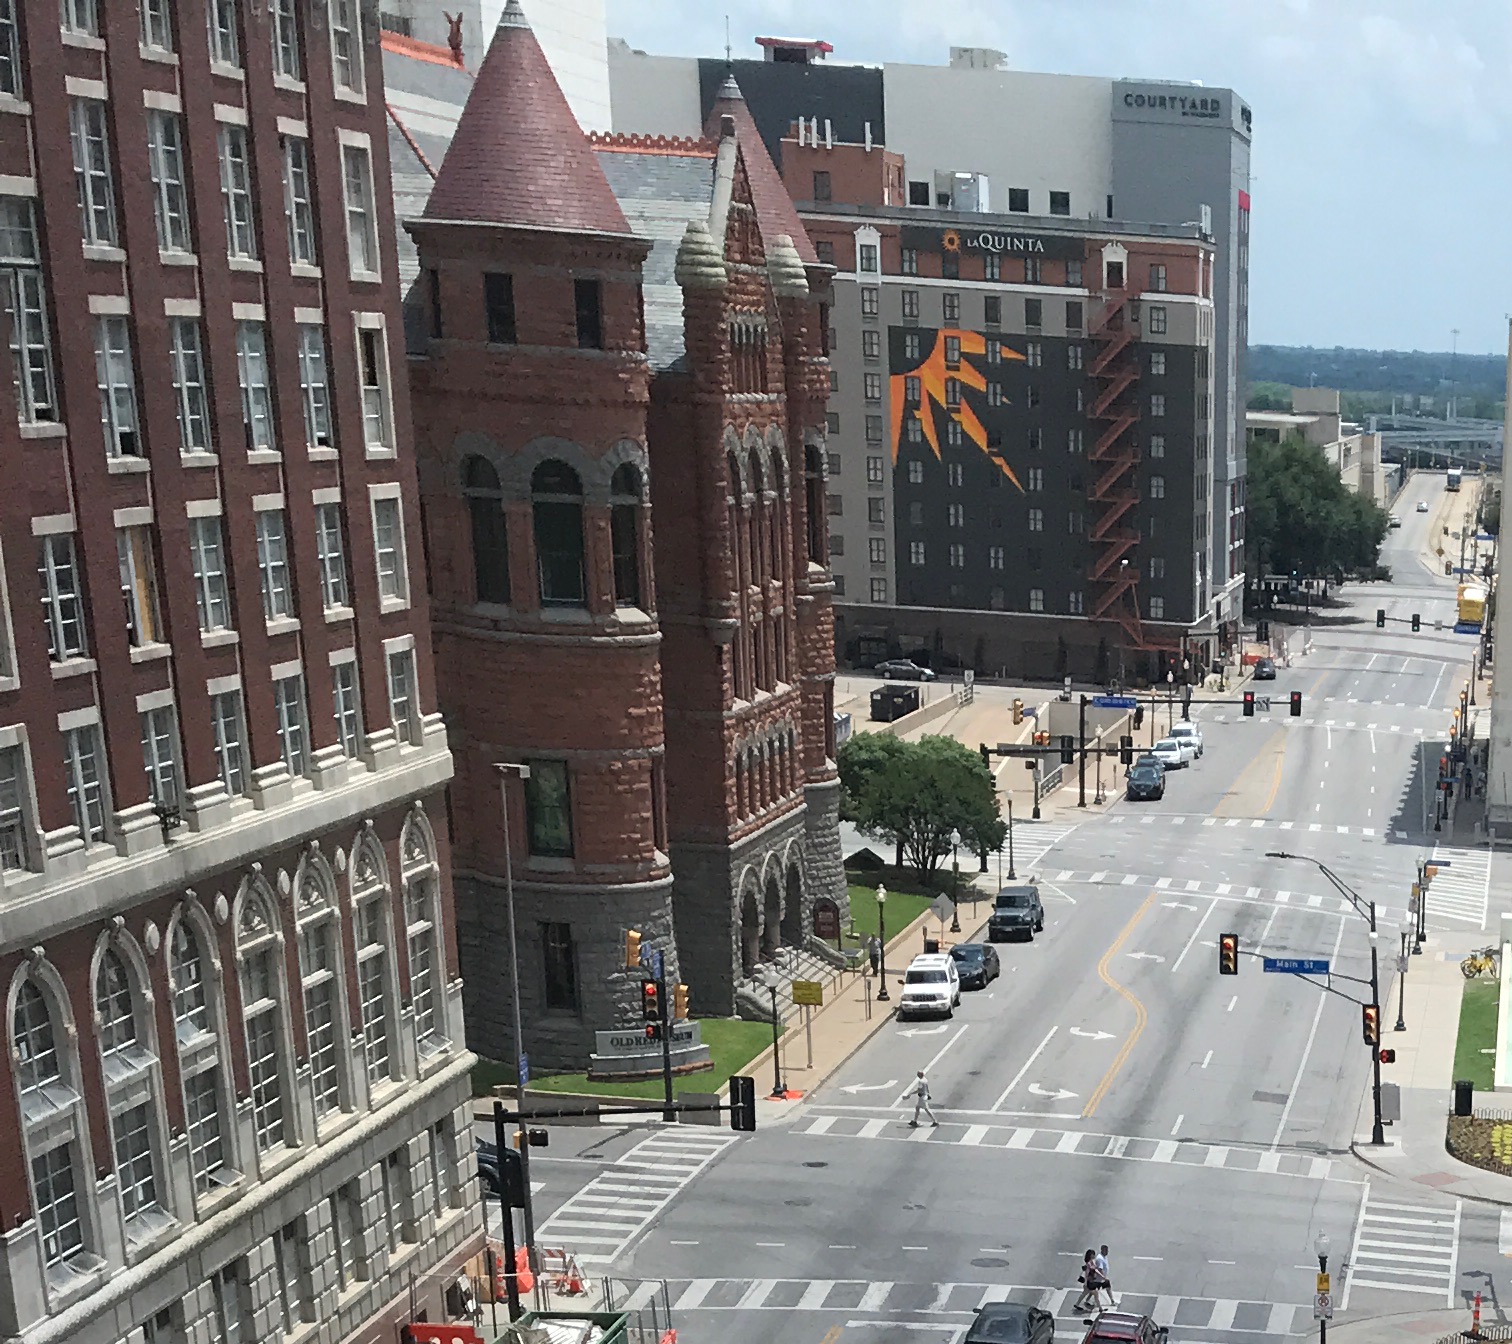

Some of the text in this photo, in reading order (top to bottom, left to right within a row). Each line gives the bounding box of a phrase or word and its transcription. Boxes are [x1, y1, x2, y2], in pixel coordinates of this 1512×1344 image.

[1124, 93, 1220, 112] COURTYARD
[1276, 960, 1314, 969] Main St
[610, 1037, 633, 1047] OLD
